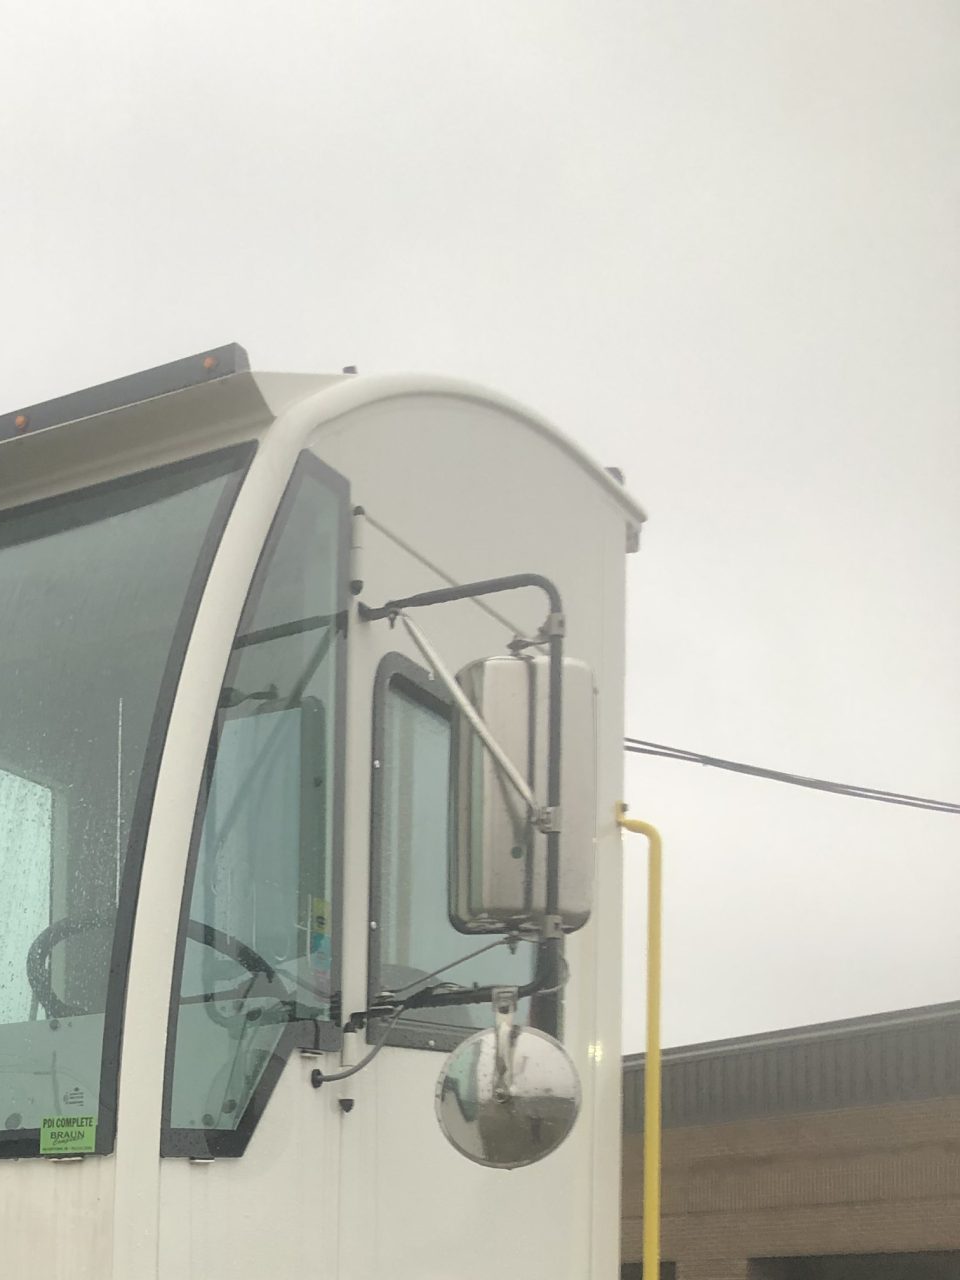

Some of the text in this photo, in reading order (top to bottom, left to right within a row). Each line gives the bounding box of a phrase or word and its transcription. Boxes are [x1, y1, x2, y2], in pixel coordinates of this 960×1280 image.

[43, 1117, 94, 1128] PDI COMPLETE
[50, 1131, 85, 1139] BRAUN
